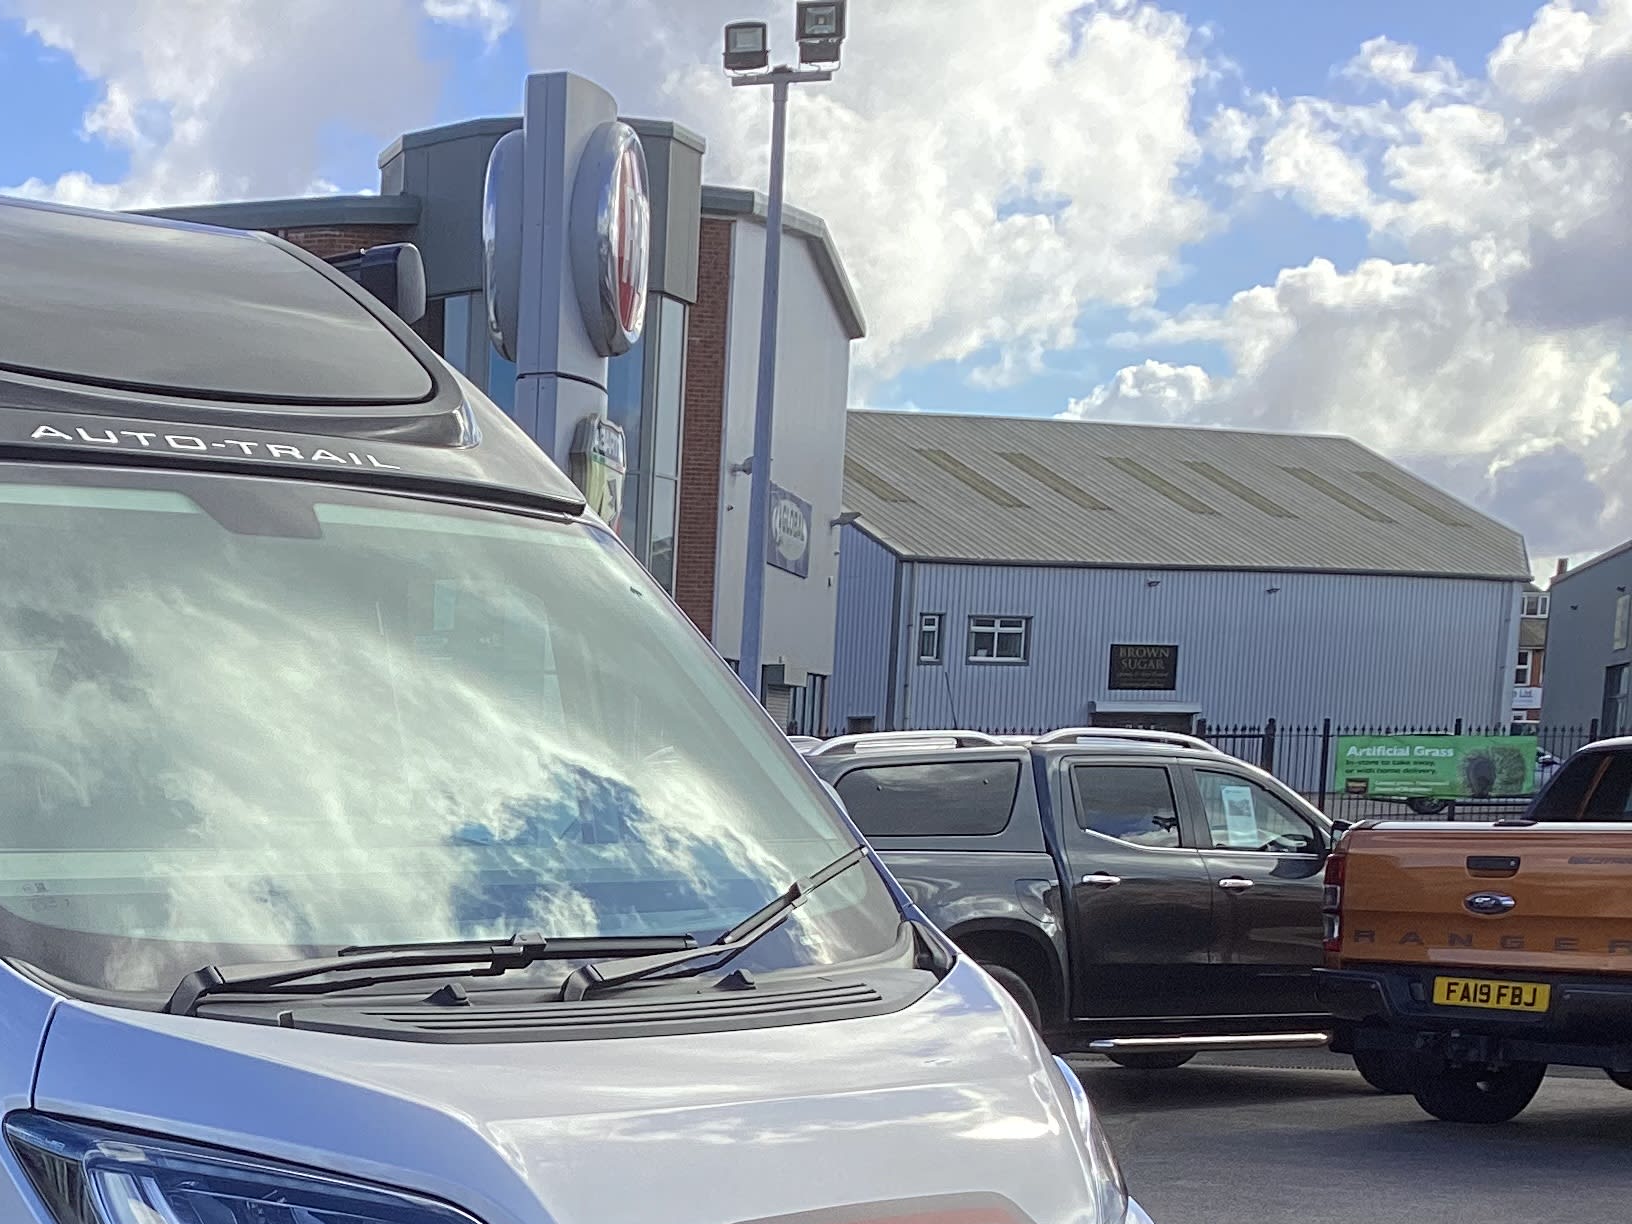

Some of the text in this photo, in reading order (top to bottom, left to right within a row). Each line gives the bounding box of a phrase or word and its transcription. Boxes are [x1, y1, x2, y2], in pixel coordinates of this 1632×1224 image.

[30, 424, 401, 470] AUTO-TRAIL
[1119, 646, 1169, 658] BROWN
[1120, 658, 1165, 670] SUGAR
[1346, 745, 1454, 758] Artificial Grass
[1353, 929, 1632, 955] RANGER
[1445, 981, 1538, 1007] FA19 FBJ
